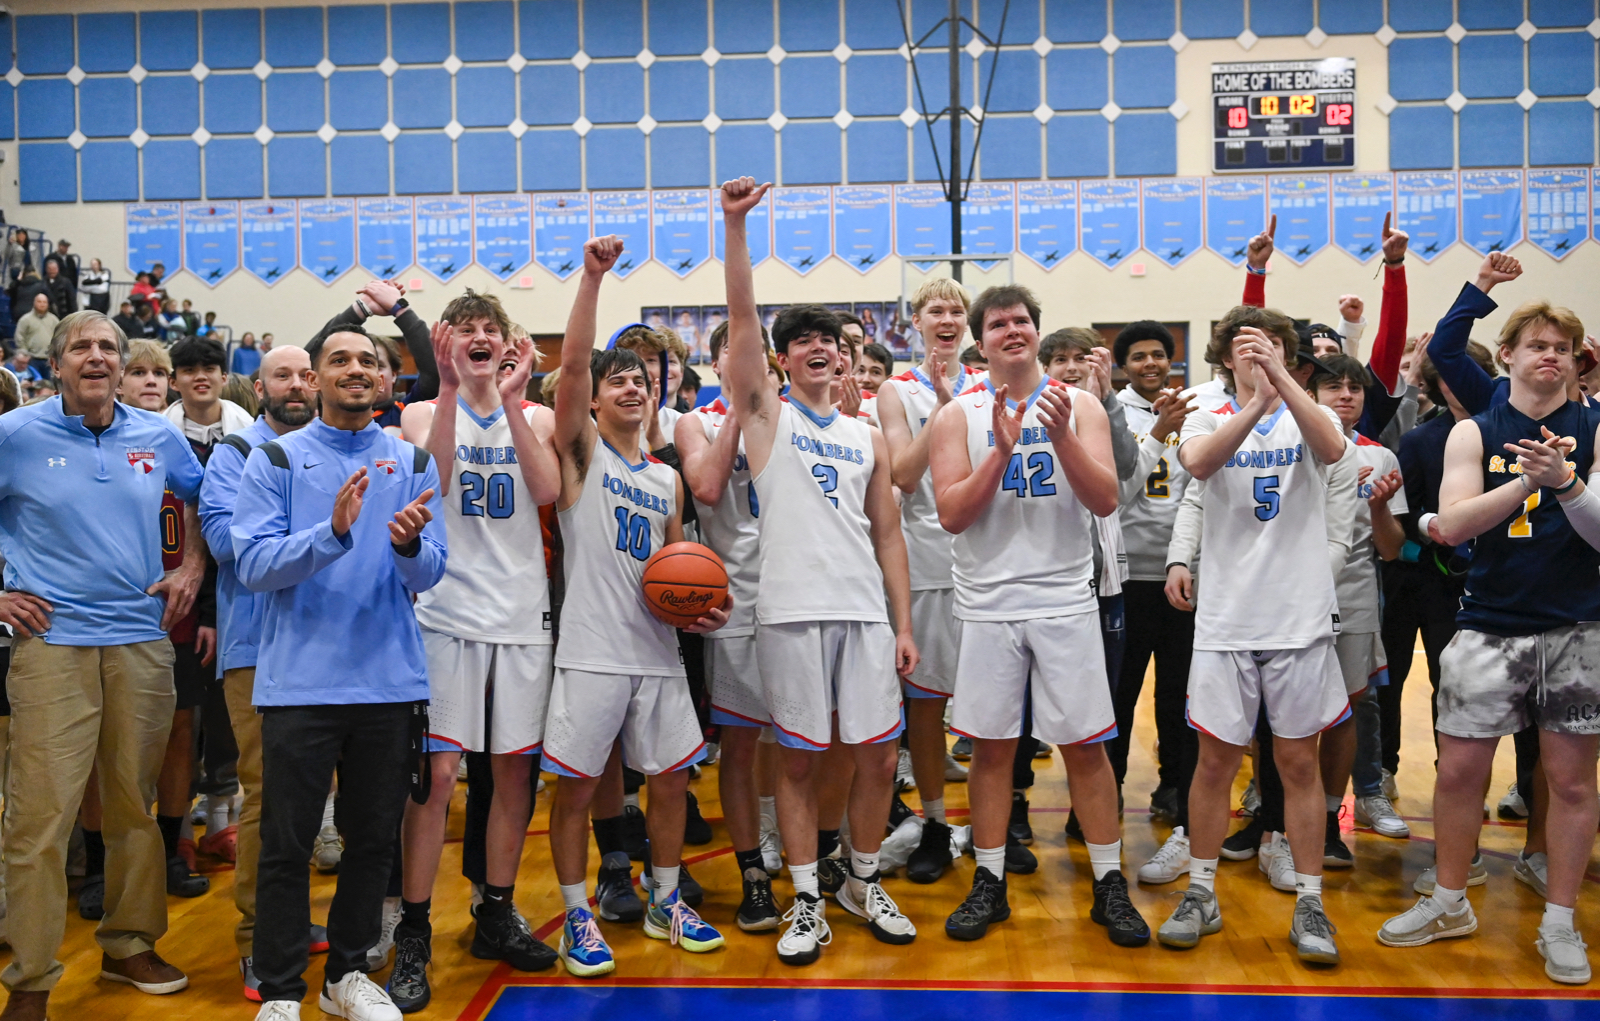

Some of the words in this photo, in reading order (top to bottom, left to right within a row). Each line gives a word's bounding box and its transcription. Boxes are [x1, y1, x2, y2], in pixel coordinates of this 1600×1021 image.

[1214, 74, 1249, 91] HOME
[1250, 73, 1267, 90] OF
[1269, 72, 1293, 89] THE
[1294, 70, 1353, 88] BOMBERS
[1218, 97, 1244, 106] HOME
[1260, 96, 1279, 115] 10
[1289, 95, 1315, 115] 02
[1228, 107, 1248, 128] 10
[1326, 104, 1352, 125] 02
[1225, 444, 1303, 468] BOMBERS
[812, 463, 838, 510] 2
[1002, 451, 1057, 498] 42
[1146, 456, 1170, 498] 2
[460, 470, 515, 519] 20
[1253, 475, 1280, 521] 5
[614, 505, 651, 562] 10
[660, 590, 715, 608] Rawlings
